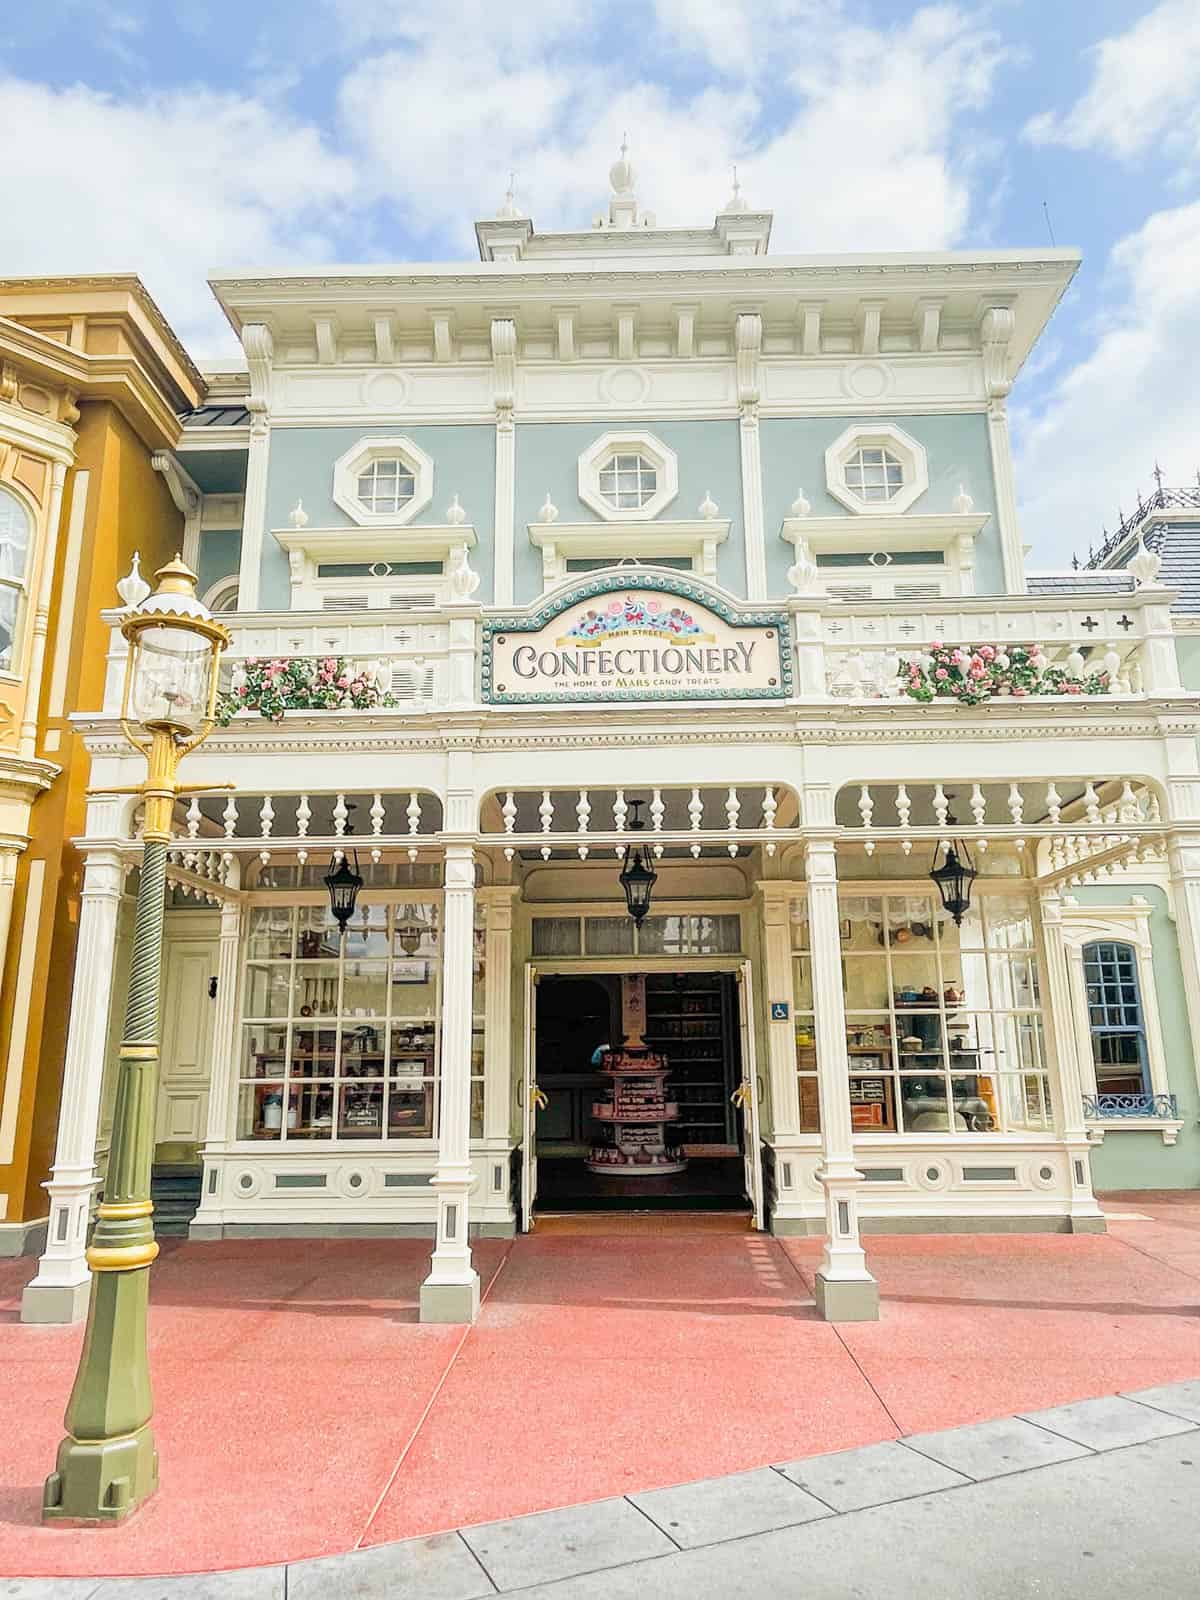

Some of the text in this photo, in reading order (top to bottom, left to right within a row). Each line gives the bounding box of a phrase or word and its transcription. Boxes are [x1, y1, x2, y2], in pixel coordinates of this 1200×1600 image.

[607, 628, 663, 638] MAIN STREET
[512, 641, 756, 679] CONFECTIONERY
[602, 680, 612, 688] OF
[653, 678, 682, 686] CANDY
[687, 678, 720, 686] TREATS
